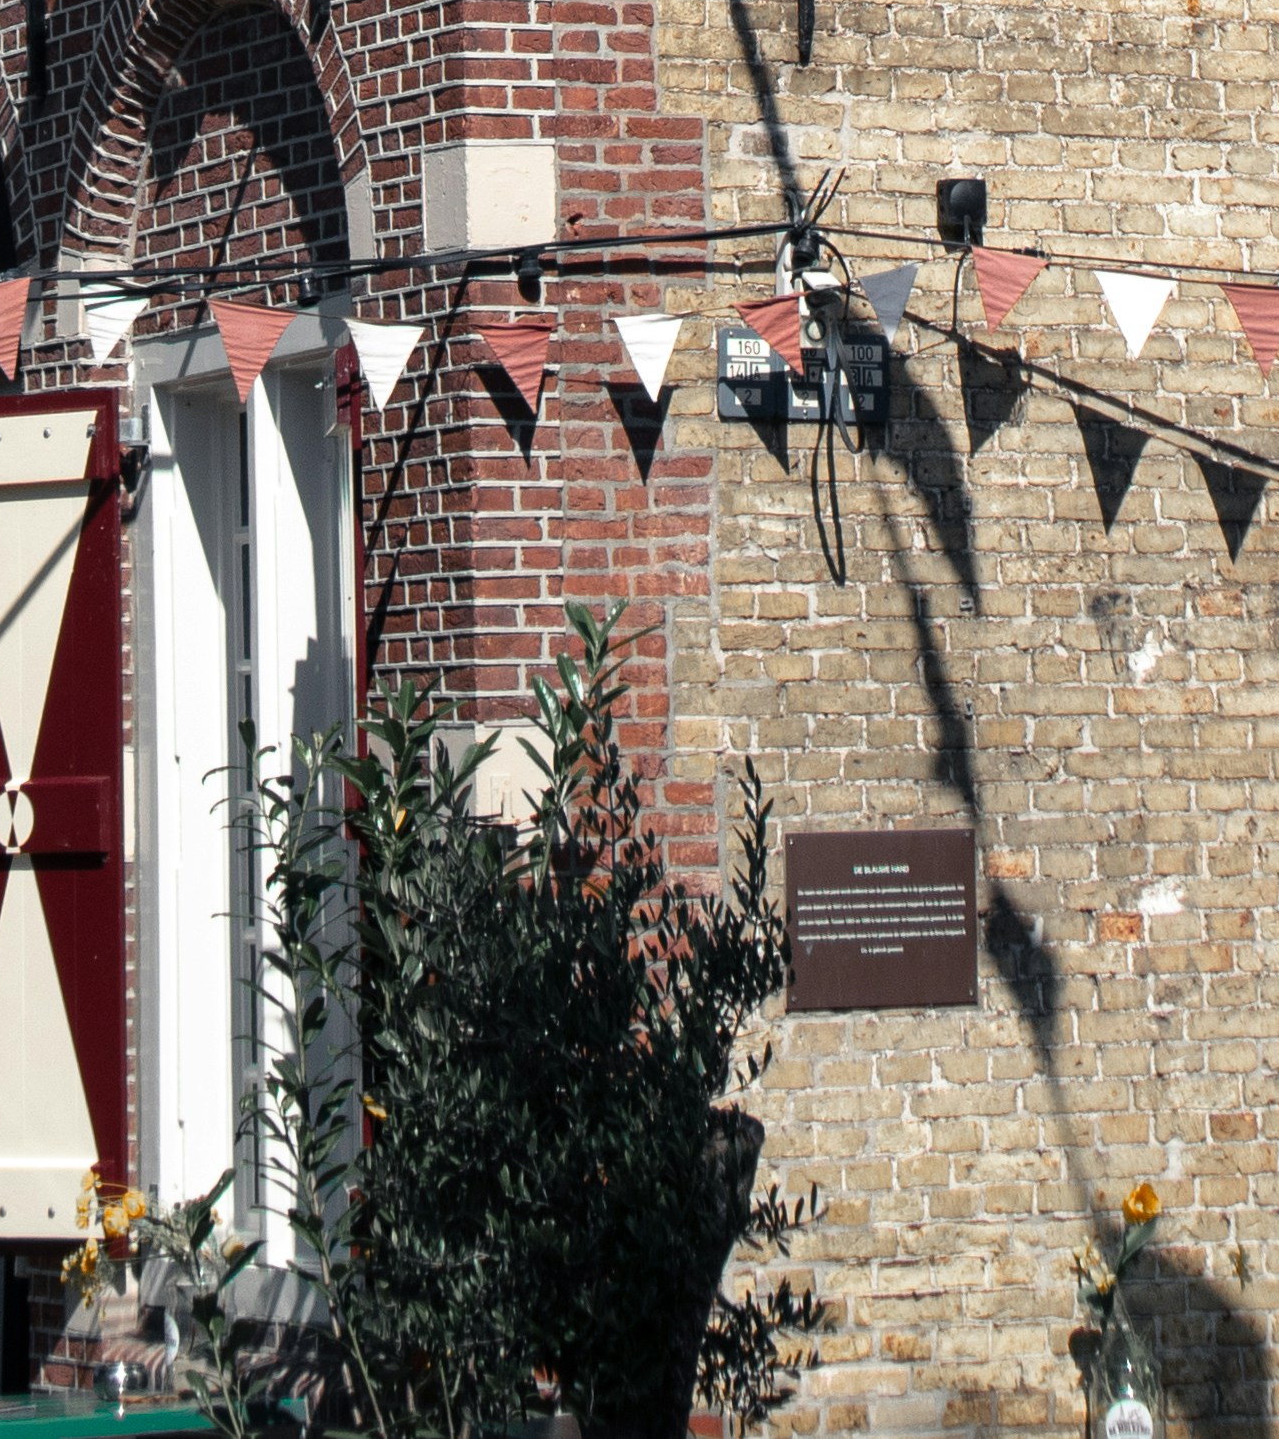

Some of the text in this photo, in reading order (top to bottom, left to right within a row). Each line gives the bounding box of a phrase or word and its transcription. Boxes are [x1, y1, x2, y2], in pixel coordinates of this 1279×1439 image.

[738, 340, 761, 355] 160
[851, 346, 874, 361] 100
[729, 364, 761, 381] 14 A
[744, 389, 753, 405] 2
[801, 391, 810, 406] 2
[858, 395, 865, 410] 2
